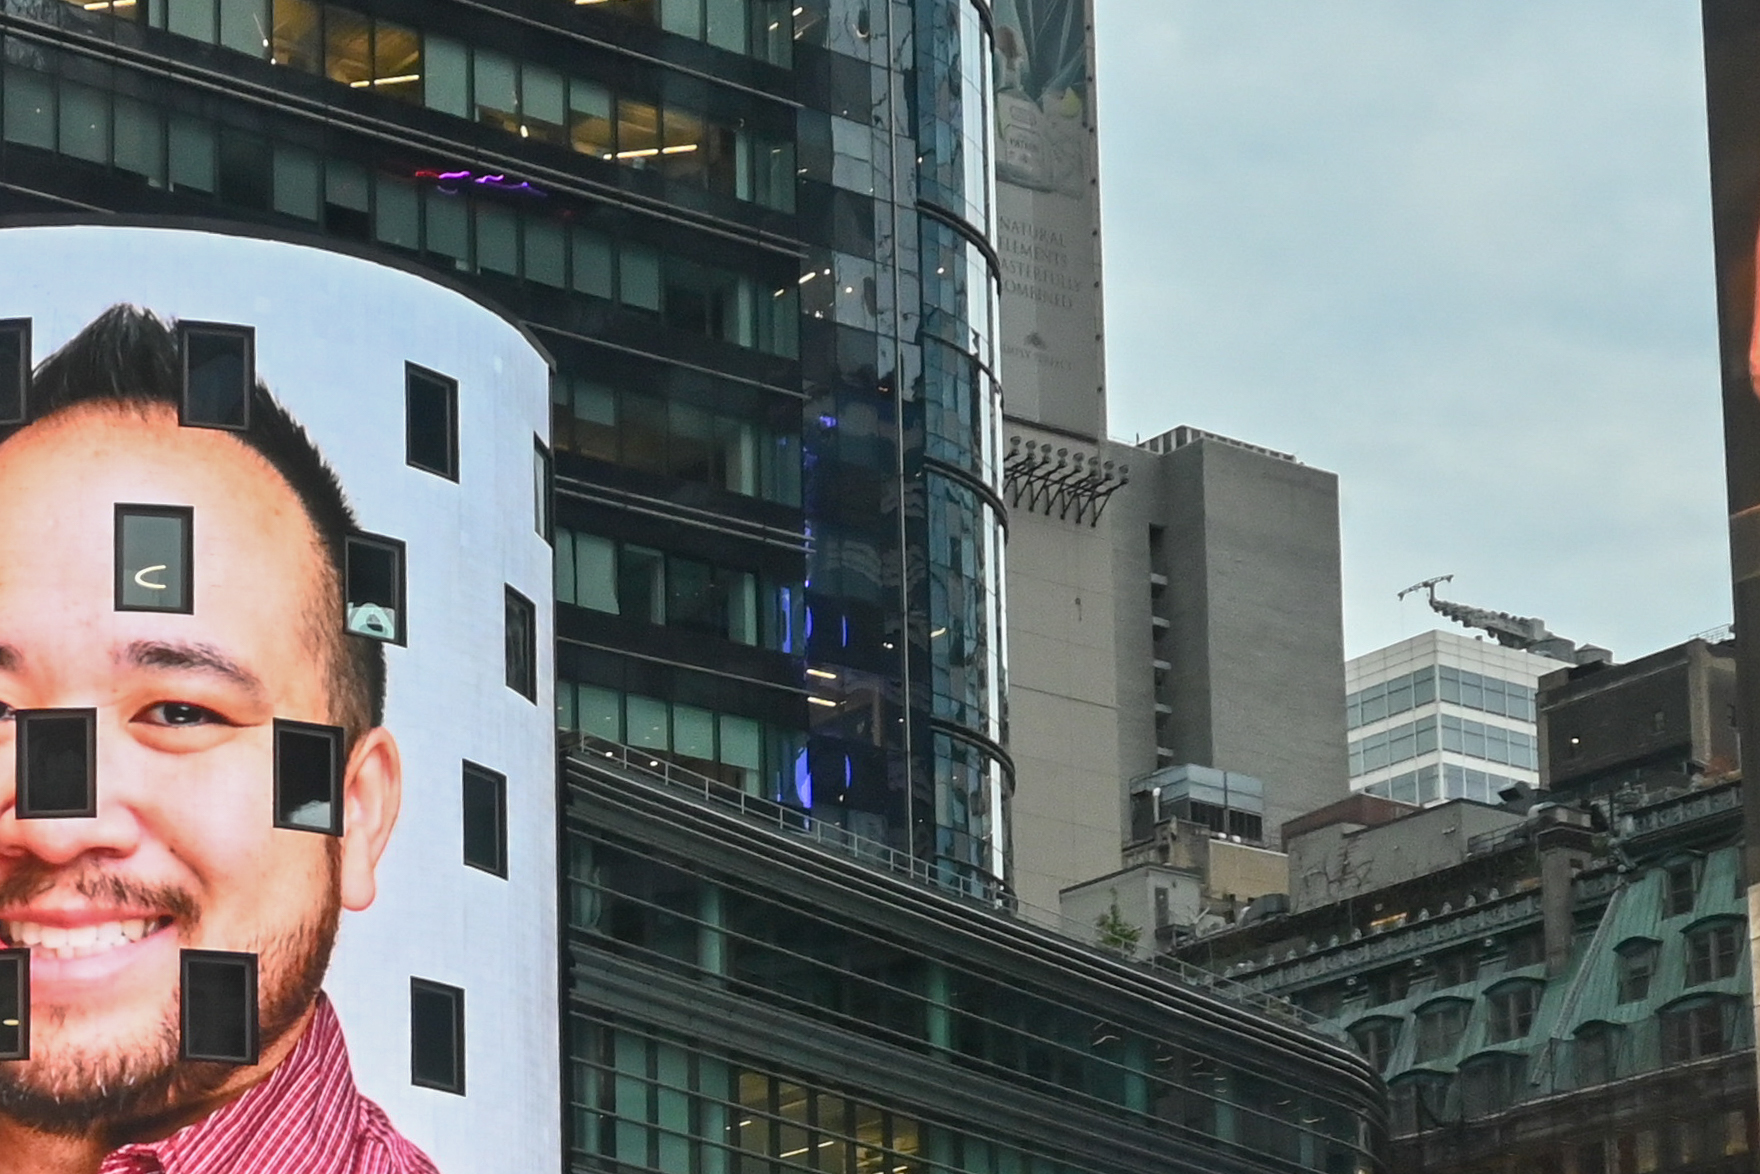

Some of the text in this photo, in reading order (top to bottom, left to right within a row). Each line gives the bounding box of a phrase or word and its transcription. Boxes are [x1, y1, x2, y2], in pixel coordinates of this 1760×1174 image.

[1000, 216, 1067, 248] NATURAL
[1001, 257, 1082, 293] ASTERFULLY
[1003, 278, 1073, 308] OMBINED
